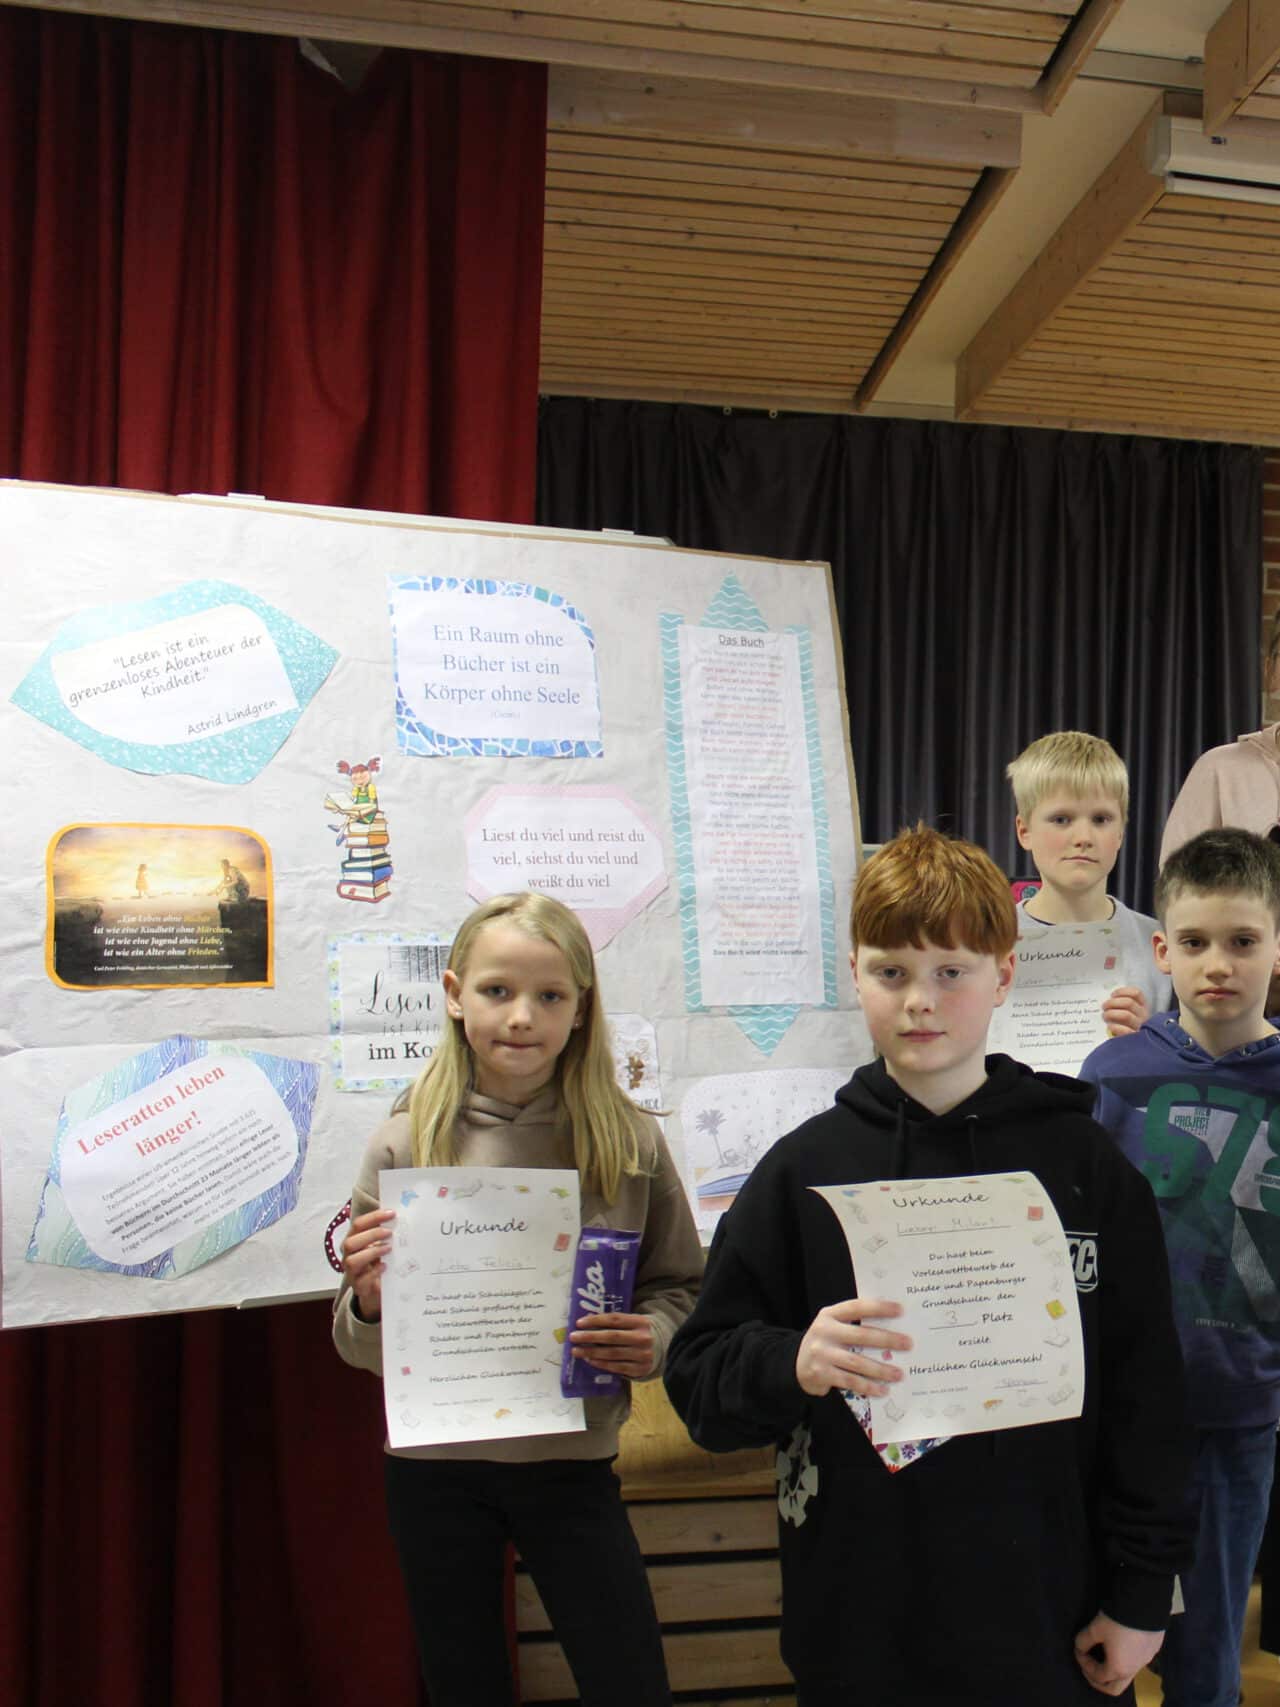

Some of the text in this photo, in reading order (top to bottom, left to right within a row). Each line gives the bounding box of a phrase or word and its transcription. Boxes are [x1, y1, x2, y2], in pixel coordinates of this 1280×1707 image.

[433, 624, 563, 647] Ein Raum ohne
[719, 634, 764, 648] Das Buch
[166, 639, 184, 656] ist
[188, 634, 209, 650] ein
[69, 635, 262, 707] grenzenloses Abenteuer der
[443, 654, 560, 675] Bücher ist ein
[424, 683, 581, 705] Körper ohne Seele
[187, 699, 278, 735] Astrid Lindgren
[482, 828, 645, 842] Liest du viel und reist du
[526, 851, 564, 865] siehst
[567, 851, 584, 865] du
[587, 851, 611, 865] viel
[614, 852, 639, 865] und
[528, 874, 610, 888] weißt du viel
[150, 937, 178, 946] Jugend
[1019, 948, 1084, 962] Urkunde
[356, 969, 436, 1018] Lesen
[369, 1043, 396, 1060] im
[78, 1065, 225, 1155] Leseratten leben
[136, 1110, 203, 1158] länger!
[892, 1193, 991, 1208] Urkunde
[440, 1219, 528, 1235] Urkunde
[929, 1248, 994, 1261] Du hast beim
[912, 1261, 1015, 1278] Vorlesewettbewerb der
[906, 1276, 1027, 1295] Rheder und Papenburger
[922, 1292, 1015, 1309] Grundschulen den
[982, 1312, 1013, 1323] Platz
[910, 1354, 1043, 1376] Herzlichen Glückwunsch!
